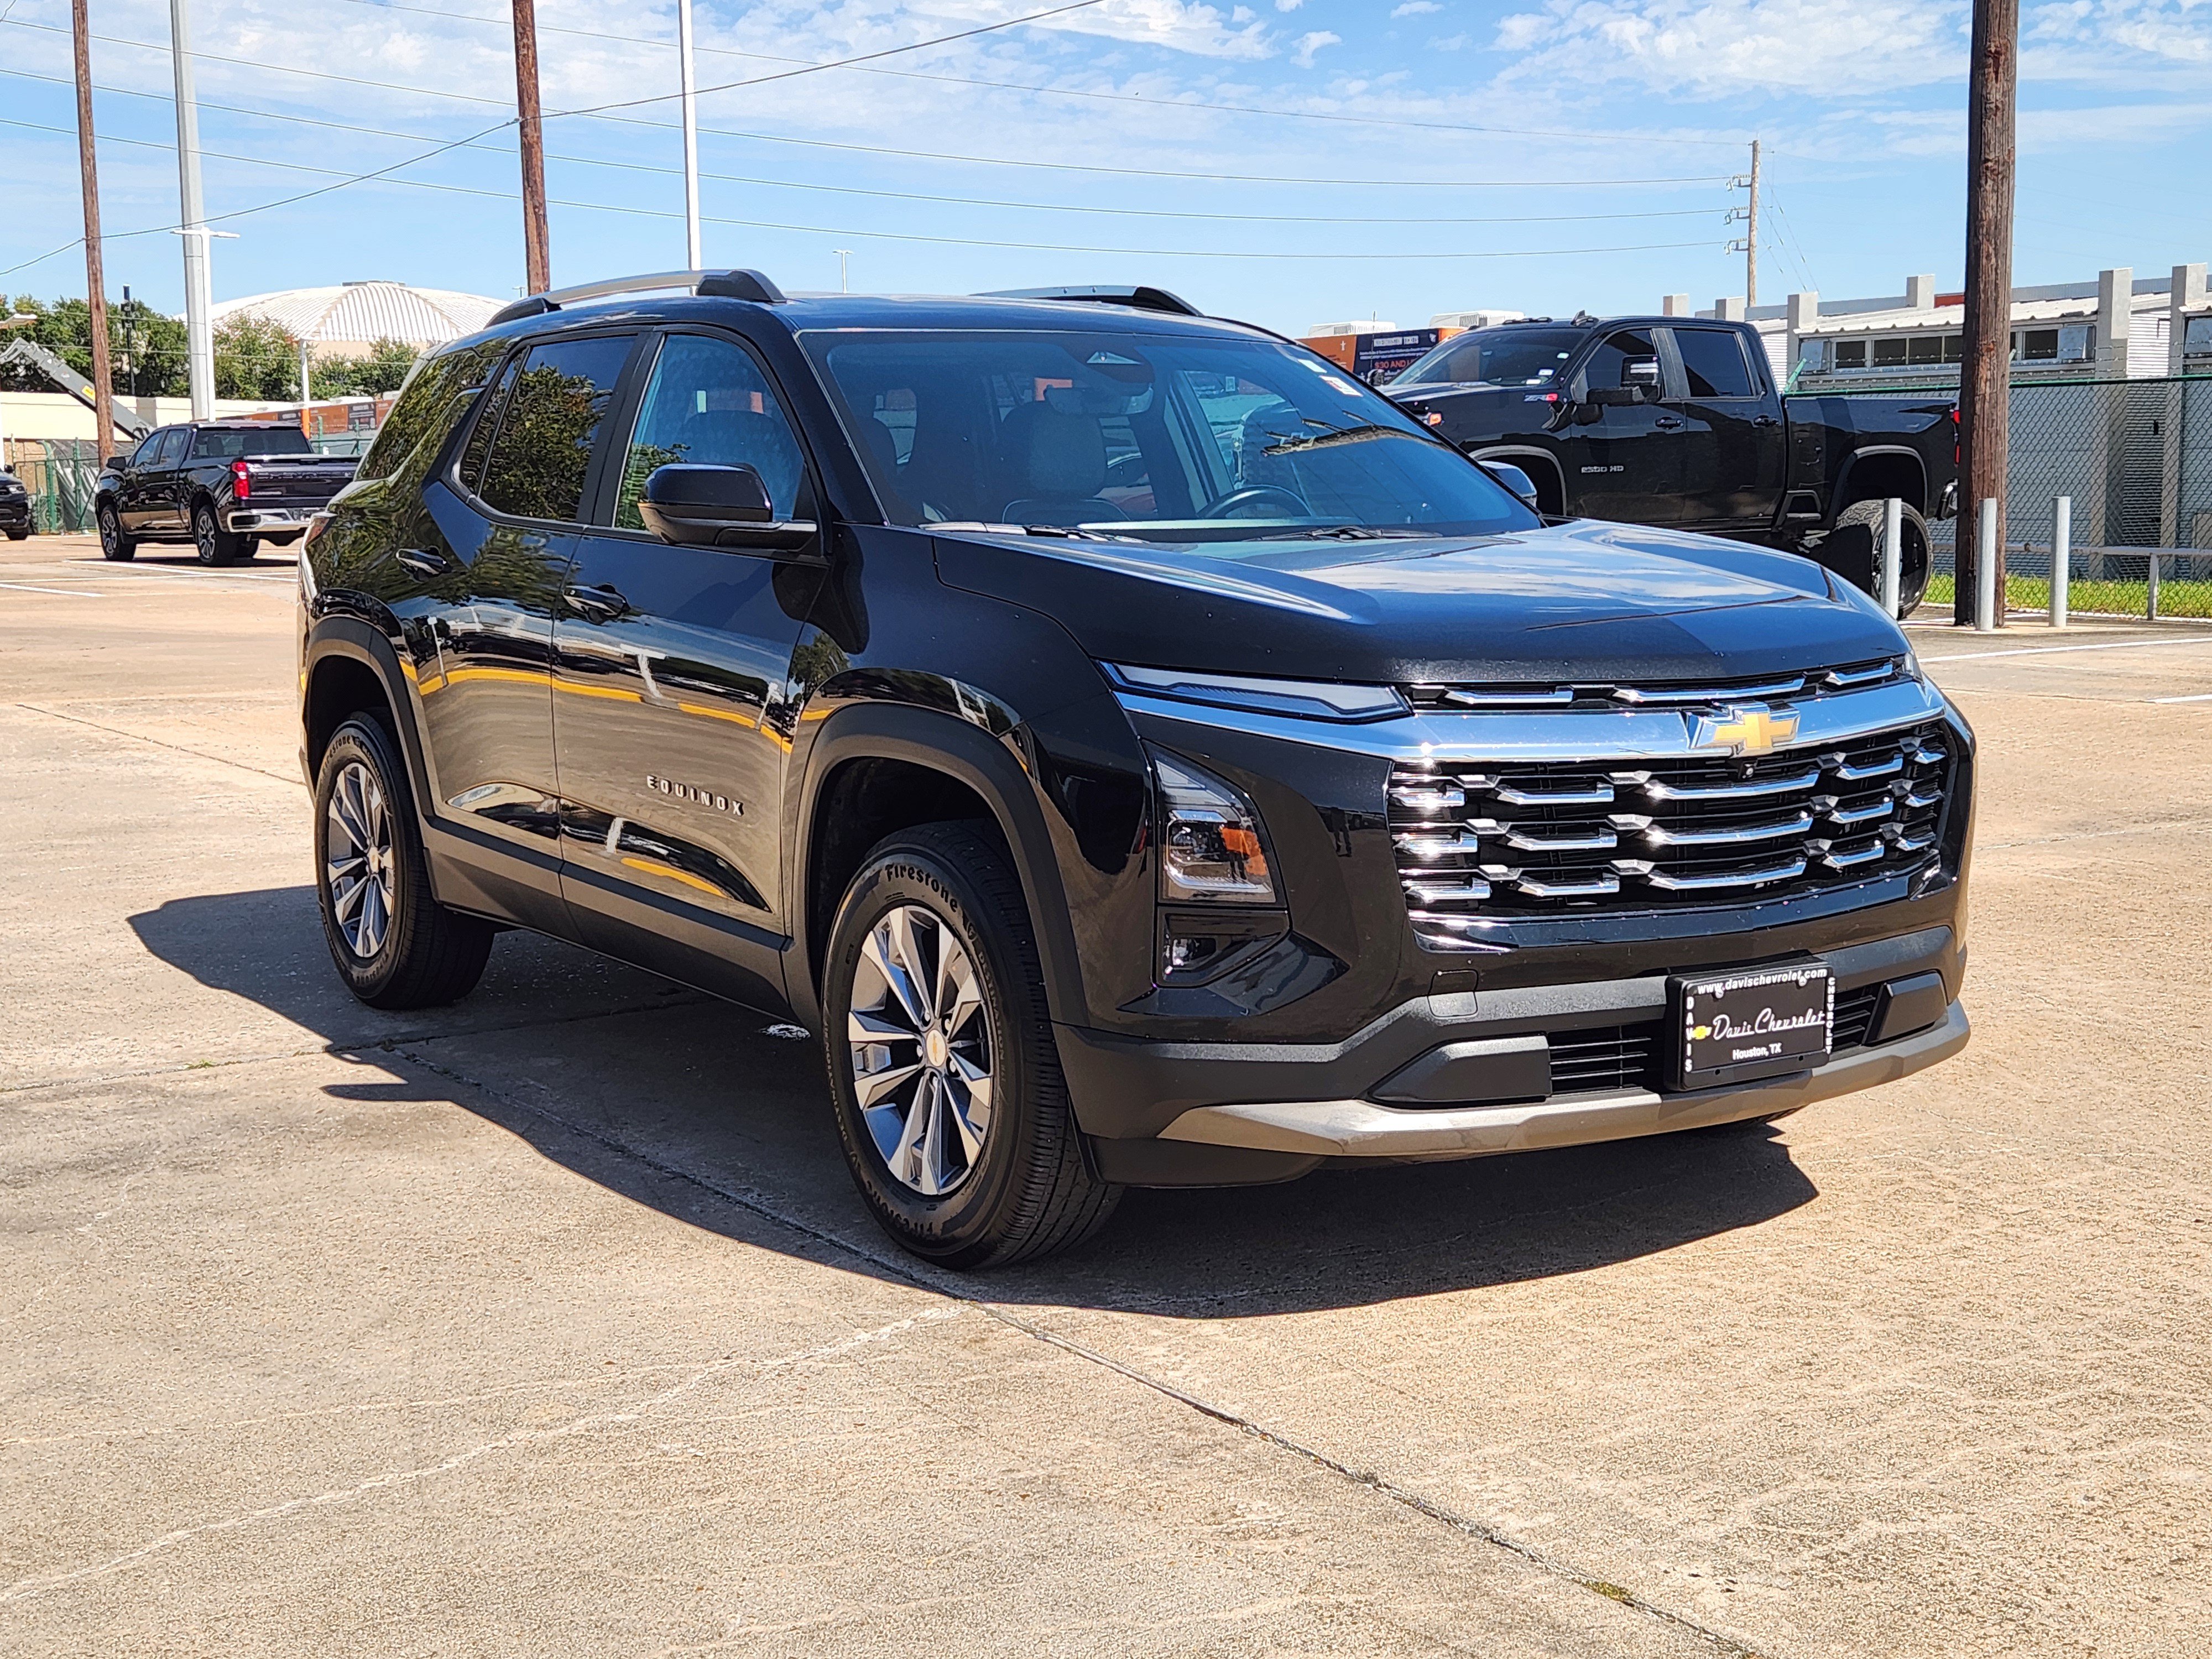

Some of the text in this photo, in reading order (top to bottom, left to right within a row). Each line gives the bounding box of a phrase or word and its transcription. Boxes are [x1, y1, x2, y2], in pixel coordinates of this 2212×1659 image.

[646, 775, 744, 816] EQUINOX
[885, 862, 958, 912] Firestone
[1697, 969, 1828, 994] www.davischevrolet.com
[1685, 995, 1694, 1072] DAVIS
[1713, 1008, 1826, 1040] Davis Chevrolet
[1825, 977, 1835, 1055] CHEVROLET
[1732, 1042, 1782, 1060] Houston, TX
